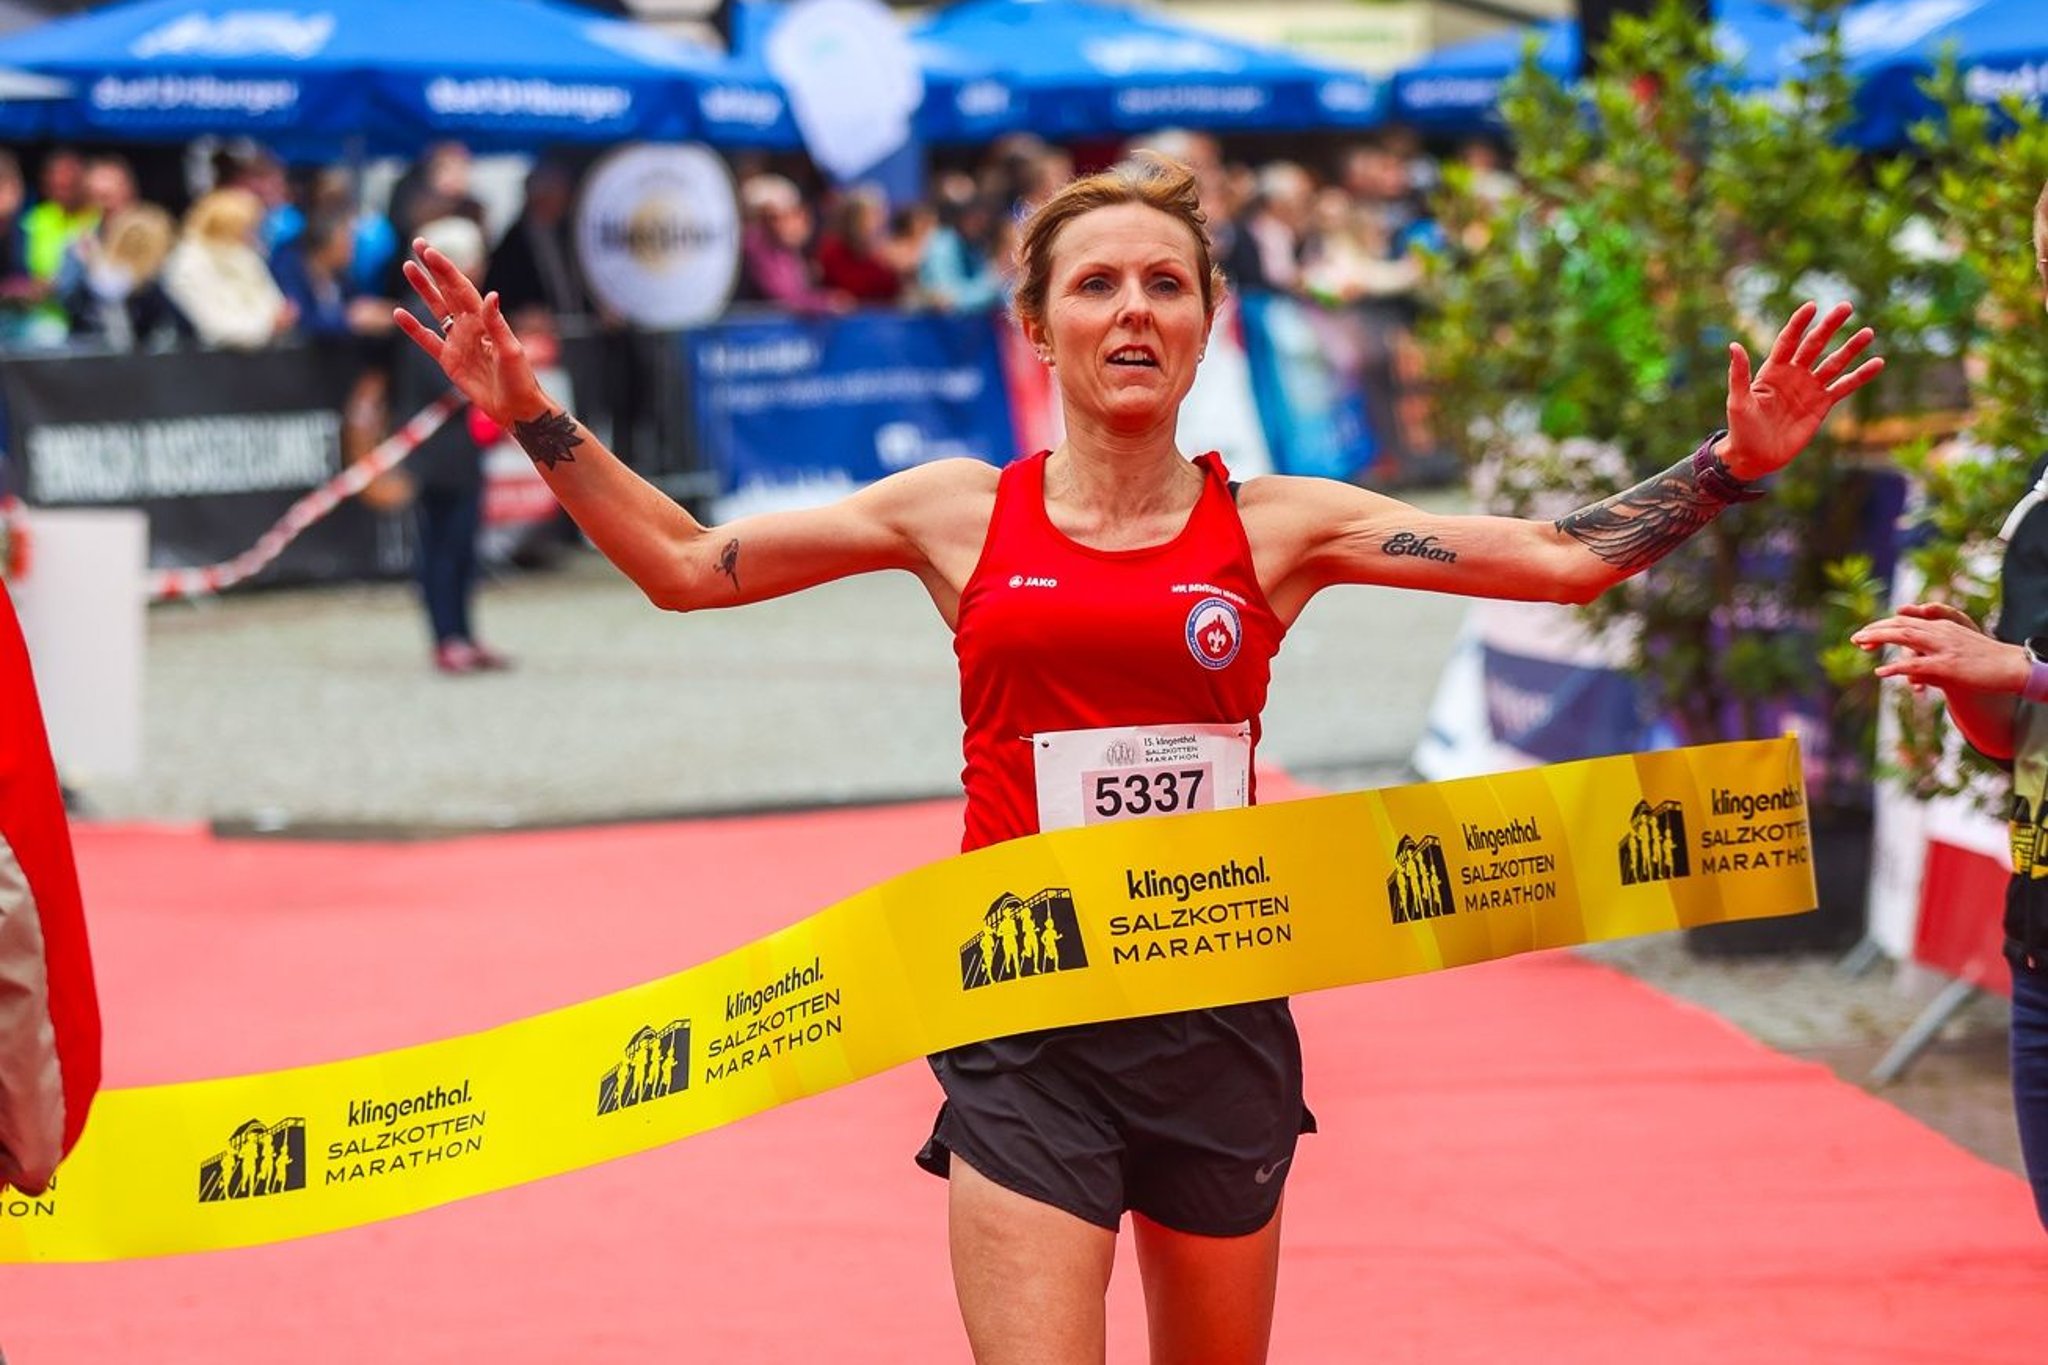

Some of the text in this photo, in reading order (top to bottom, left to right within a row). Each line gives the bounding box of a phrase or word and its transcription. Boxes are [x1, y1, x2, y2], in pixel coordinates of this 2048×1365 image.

[1381, 532, 1458, 564] Ethan
[1024, 576, 1058, 588] JAKO
[1145, 745, 1199, 757] SALZKOTTEN
[1145, 753, 1199, 764] MARATHON
[1095, 769, 1205, 817] 5337
[1461, 815, 1542, 856] klingenthal.
[1126, 856, 1271, 902] klingenthal.
[1461, 853, 1555, 886] SALZKOTTEN
[1109, 895, 1291, 937] SALZKOTTEN
[1464, 881, 1556, 913] MARATHON
[1112, 923, 1292, 965] MARATHON
[725, 956, 824, 1022] klingenthal.
[708, 988, 841, 1058] SALZKOTTEN
[705, 1015, 842, 1084] MARATHON
[347, 1079, 473, 1128] klingenthal.
[327, 1109, 486, 1161] SALZKOTTEN
[325, 1135, 483, 1186] MARATHON
[0, 1200, 55, 1217] ON
